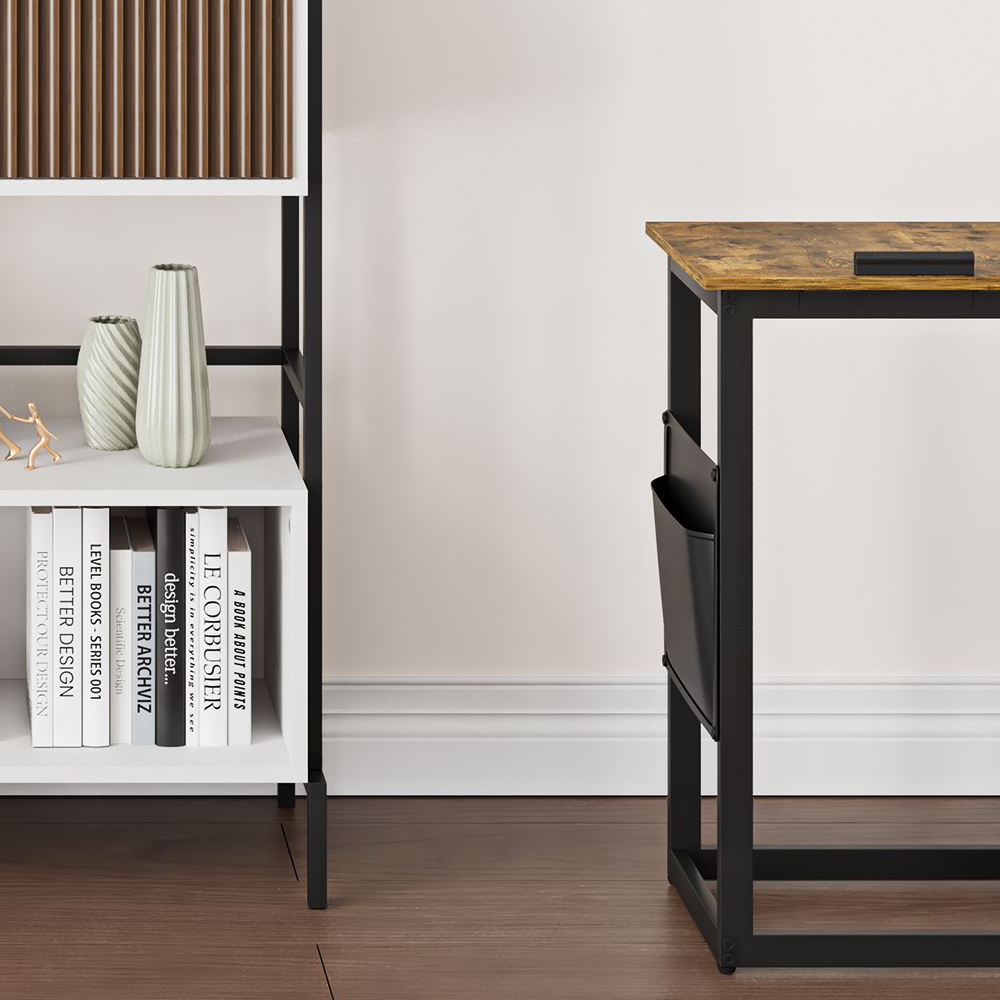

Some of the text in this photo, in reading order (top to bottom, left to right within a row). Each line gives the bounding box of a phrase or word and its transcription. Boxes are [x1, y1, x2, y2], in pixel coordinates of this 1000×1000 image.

[90, 544, 102, 579] LEVEL
[90, 583, 102, 625] BOOKS
[189, 593, 196, 602] is
[189, 607, 196, 618] in
[233, 601, 246, 629] BOOK
[36, 551, 49, 717] PROTECT OUR DESIGN
[59, 567, 74, 697] BETTER DESIGN
[137, 585, 152, 713] BETTER ARCHVIZ
[160, 573, 179, 685] design better...
[203, 552, 222, 712] LE CORBUSIER
[90, 635, 102, 676] SERIES
[114, 607, 126, 695] Scientific Design
[188, 623, 196, 688] everything
[233, 633, 246, 668] ABOUT
[90, 679, 102, 701] 001
[189, 693, 195, 708] we
[233, 672, 246, 710] POINTS
